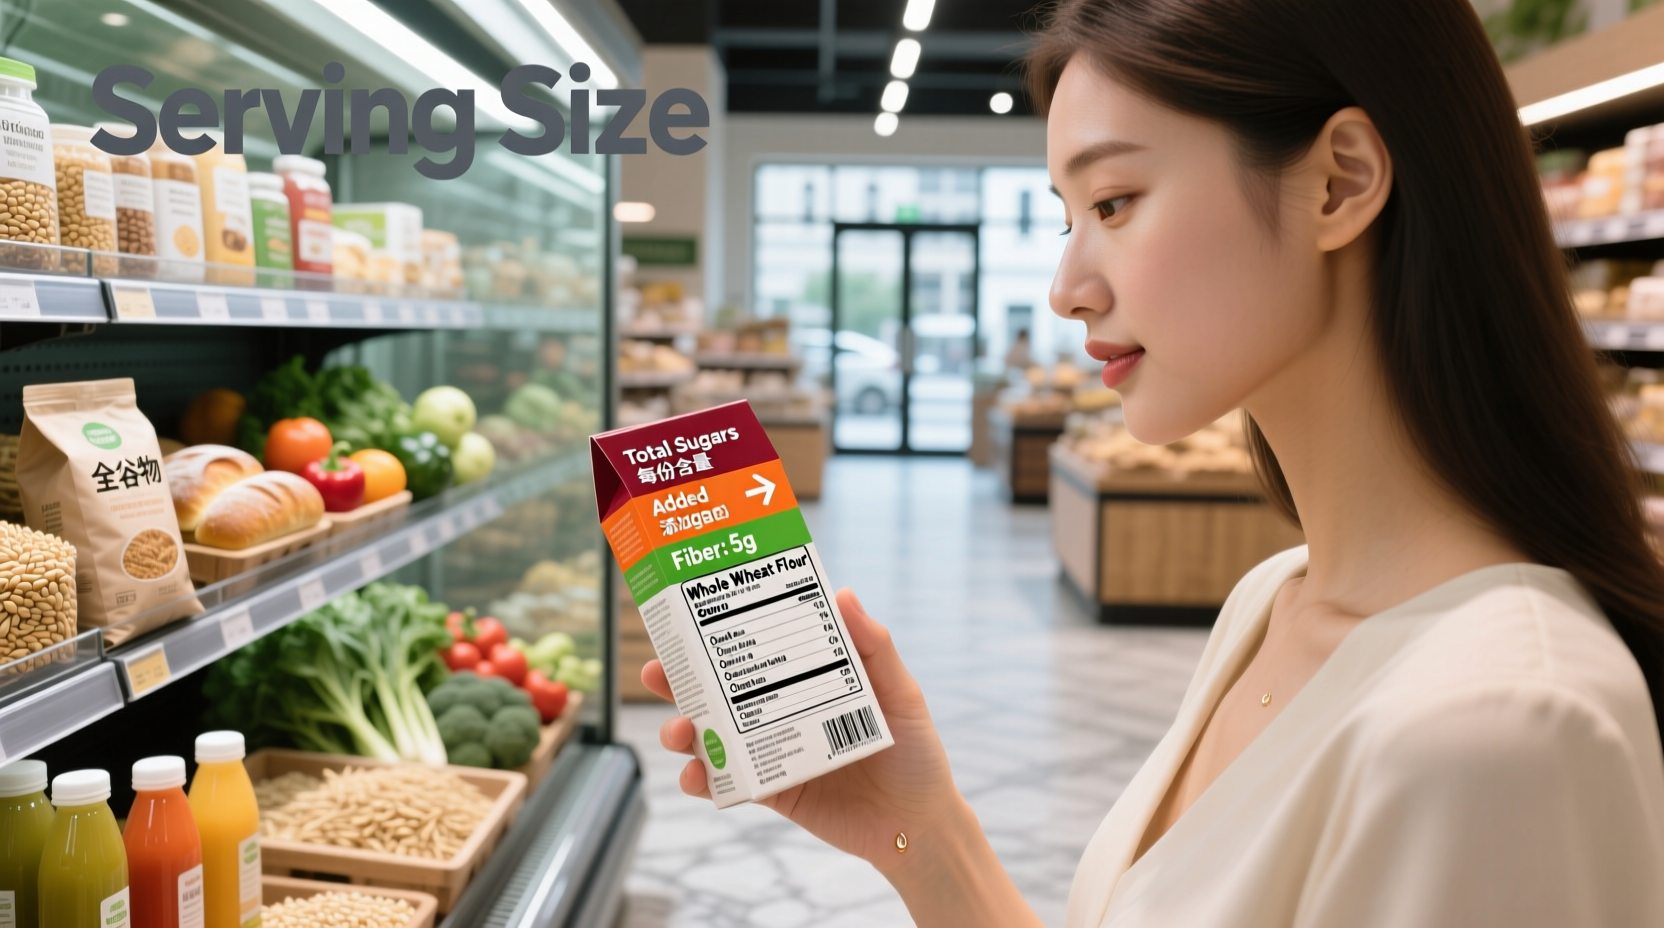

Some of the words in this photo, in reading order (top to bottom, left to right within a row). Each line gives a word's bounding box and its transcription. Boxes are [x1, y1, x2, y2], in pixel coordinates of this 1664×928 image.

[622, 440, 673, 465] Total
[674, 427, 740, 451] Sugars
[91, 455, 162, 493] 全谷物
[637, 452, 714, 484] 每份含量
[653, 485, 709, 517] Added
[671, 541, 729, 571] Fiber:
[729, 533, 758, 555] 5g
[686, 577, 730, 601] Whole
[729, 563, 775, 587] Wheat
[775, 554, 808, 573] Flour
